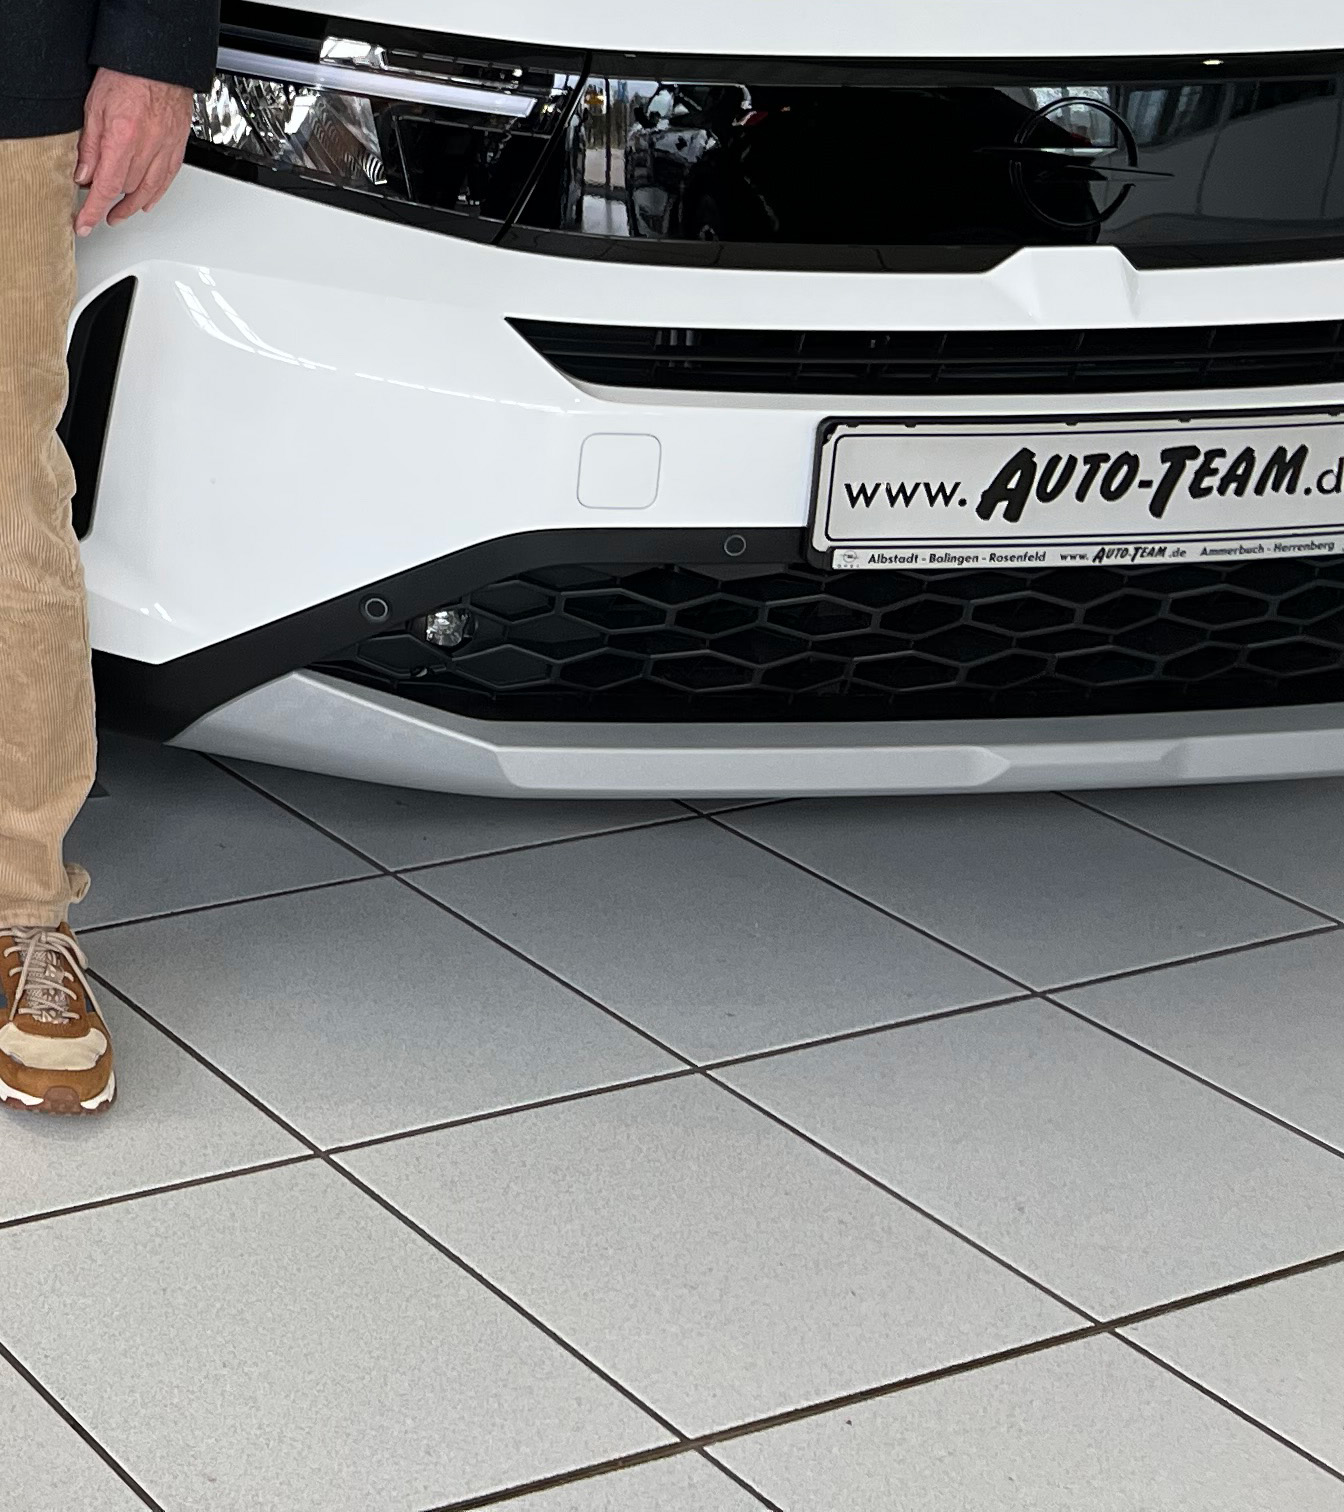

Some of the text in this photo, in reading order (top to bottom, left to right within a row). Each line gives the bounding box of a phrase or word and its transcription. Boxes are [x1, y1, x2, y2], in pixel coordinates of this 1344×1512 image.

[867, 552, 919, 564] Albstadt
[929, 552, 979, 566] Balingen
[989, 551, 1047, 563] Rosenfeld
[1200, 544, 1265, 556] Ammerbuch
[1273, 540, 1335, 552] Herrenberg
